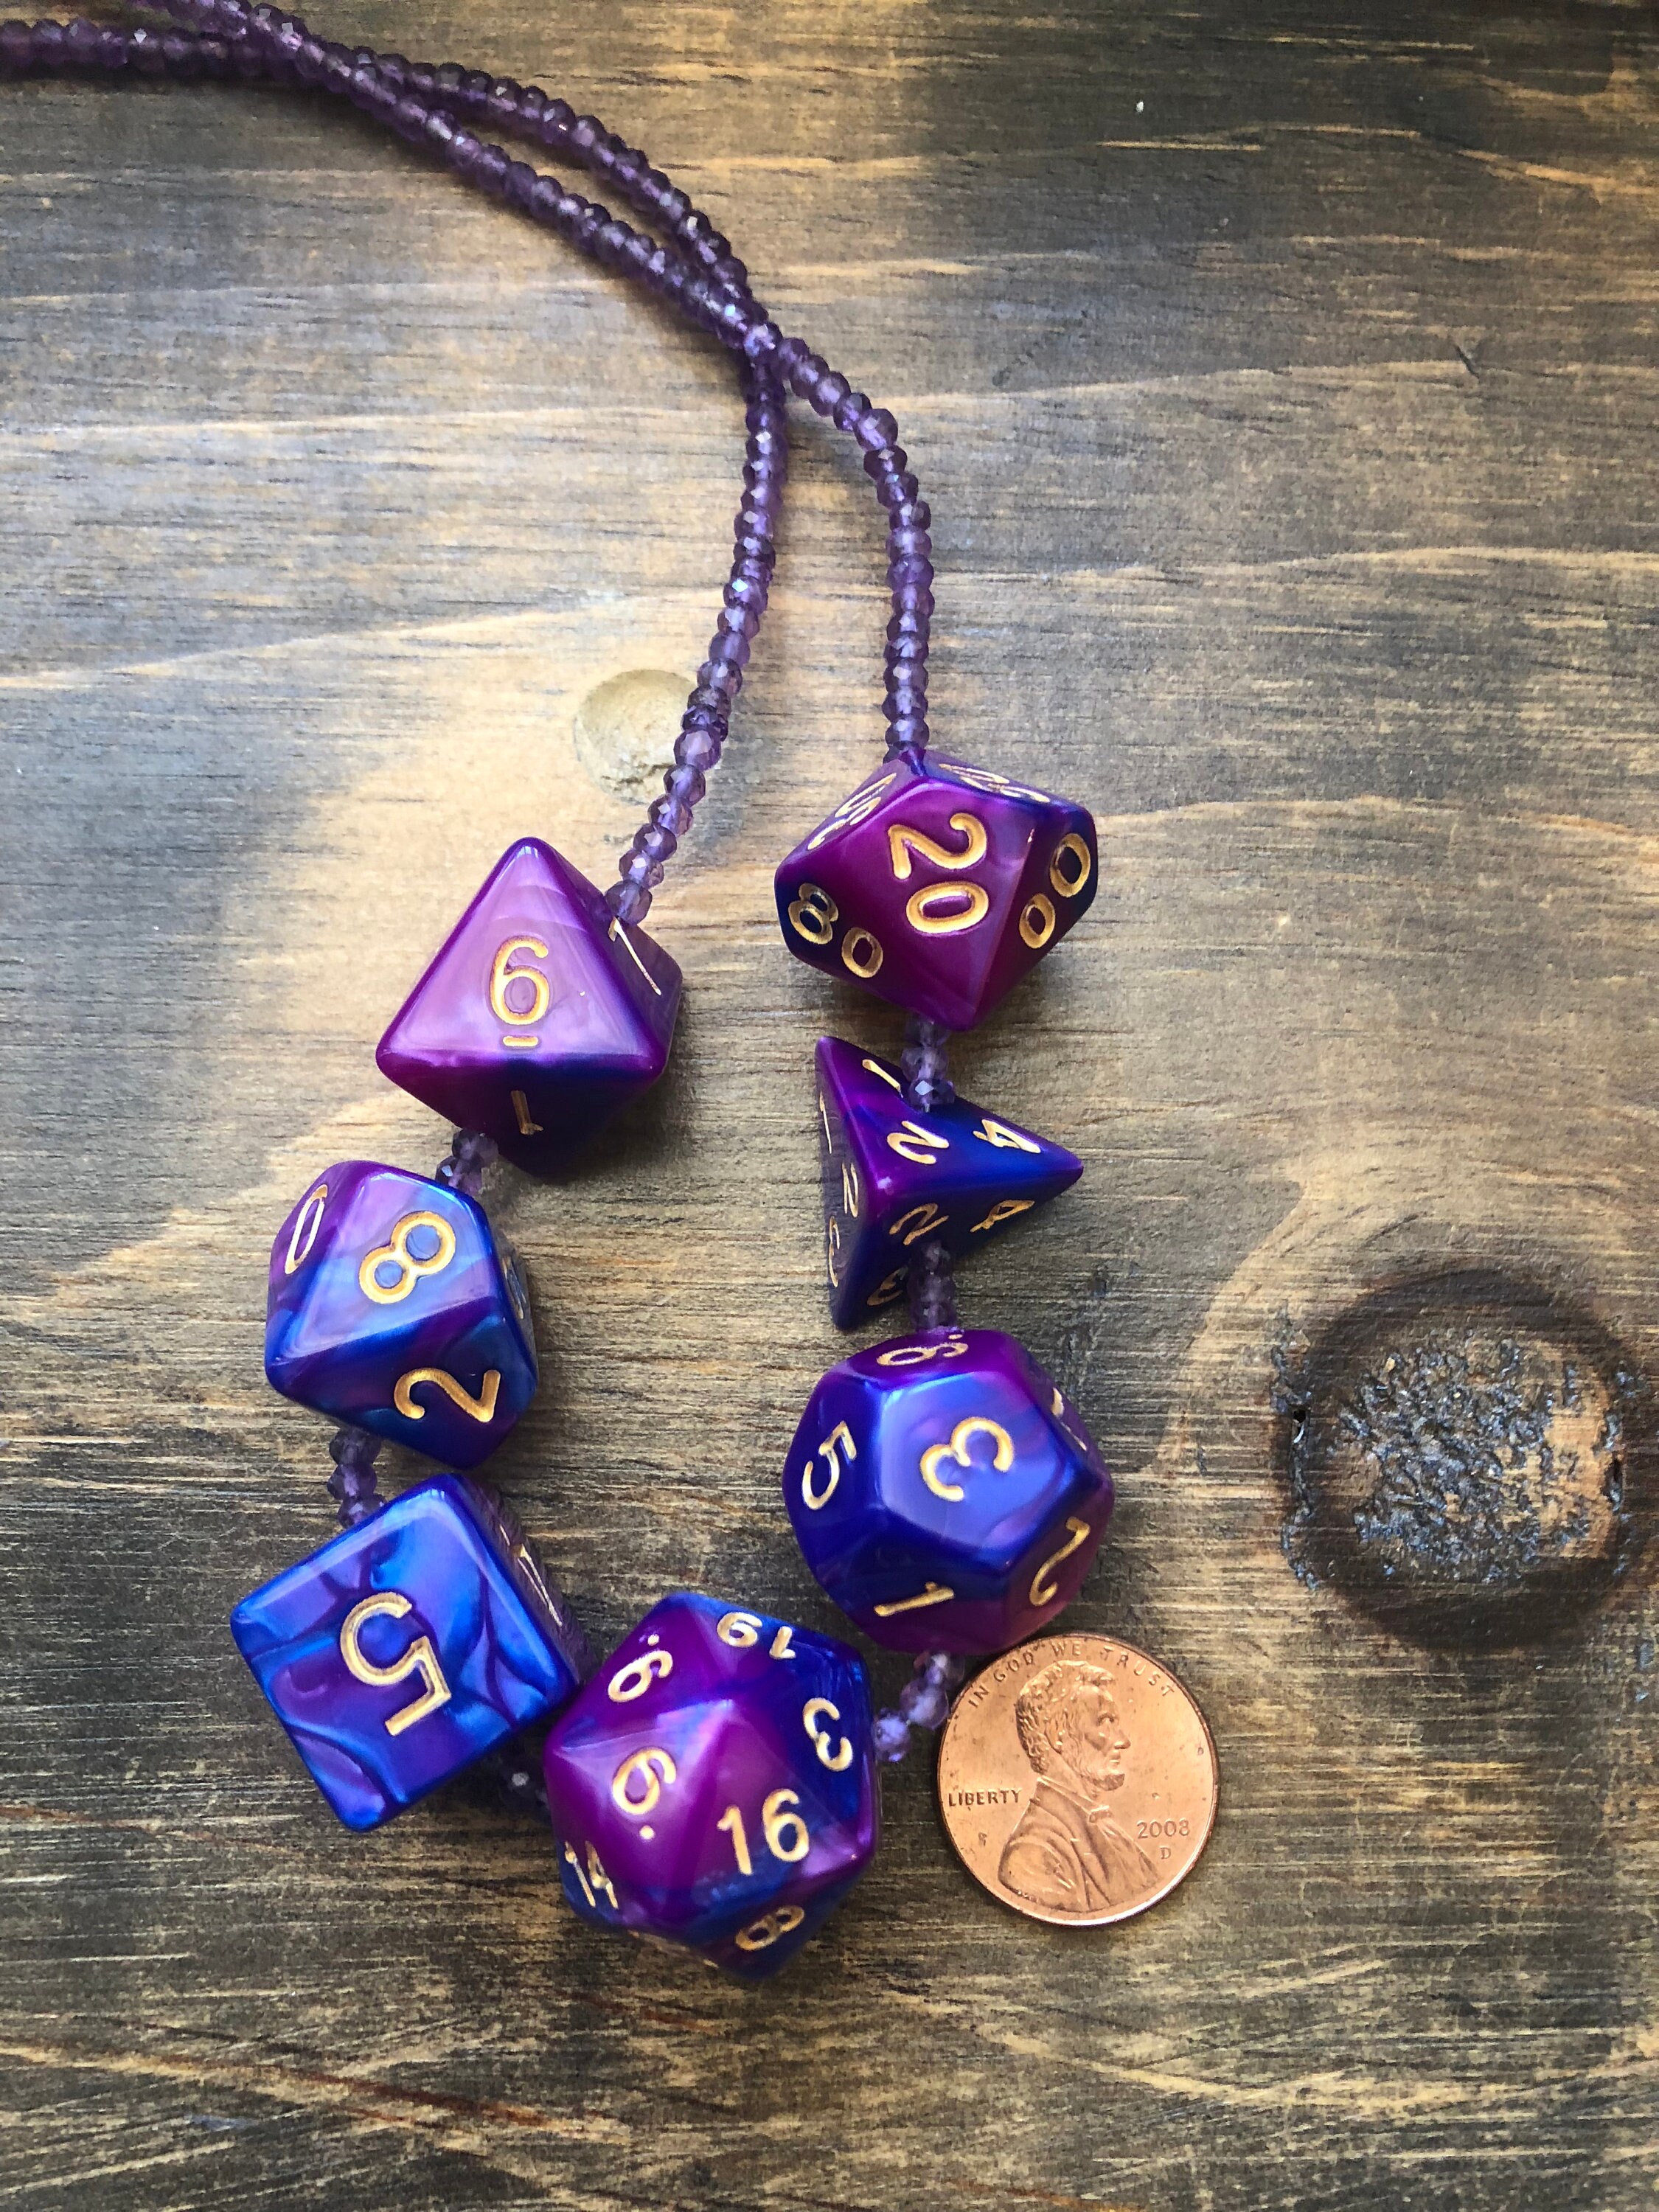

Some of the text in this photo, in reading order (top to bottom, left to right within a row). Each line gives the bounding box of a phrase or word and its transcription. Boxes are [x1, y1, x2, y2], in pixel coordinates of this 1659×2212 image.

[888, 813, 990, 934] 20
[788, 883, 883, 978] 80
[861, 1059, 904, 1098] 1
[886, 1120, 950, 1165] 2
[285, 1183, 328, 1275] 0
[358, 1211, 456, 1305] 8
[888, 1202, 950, 1246] 2
[394, 1367, 501, 1423] 2
[801, 1420, 858, 1511] 5
[919, 1416, 1015, 1503] 3
[873, 1580, 955, 1618] 1
[339, 1591, 453, 1737] 5
[968, 1640, 1176, 1708] IN GOD WE TRUST
[802, 1697, 854, 1772] 3
[947, 1787, 1023, 1807] LIBERTY
[1135, 1819, 1191, 1839] 2008
[716, 1787, 810, 1876] 16
[1160, 1846, 1172, 1860] D
[734, 1905, 805, 1952] 8
